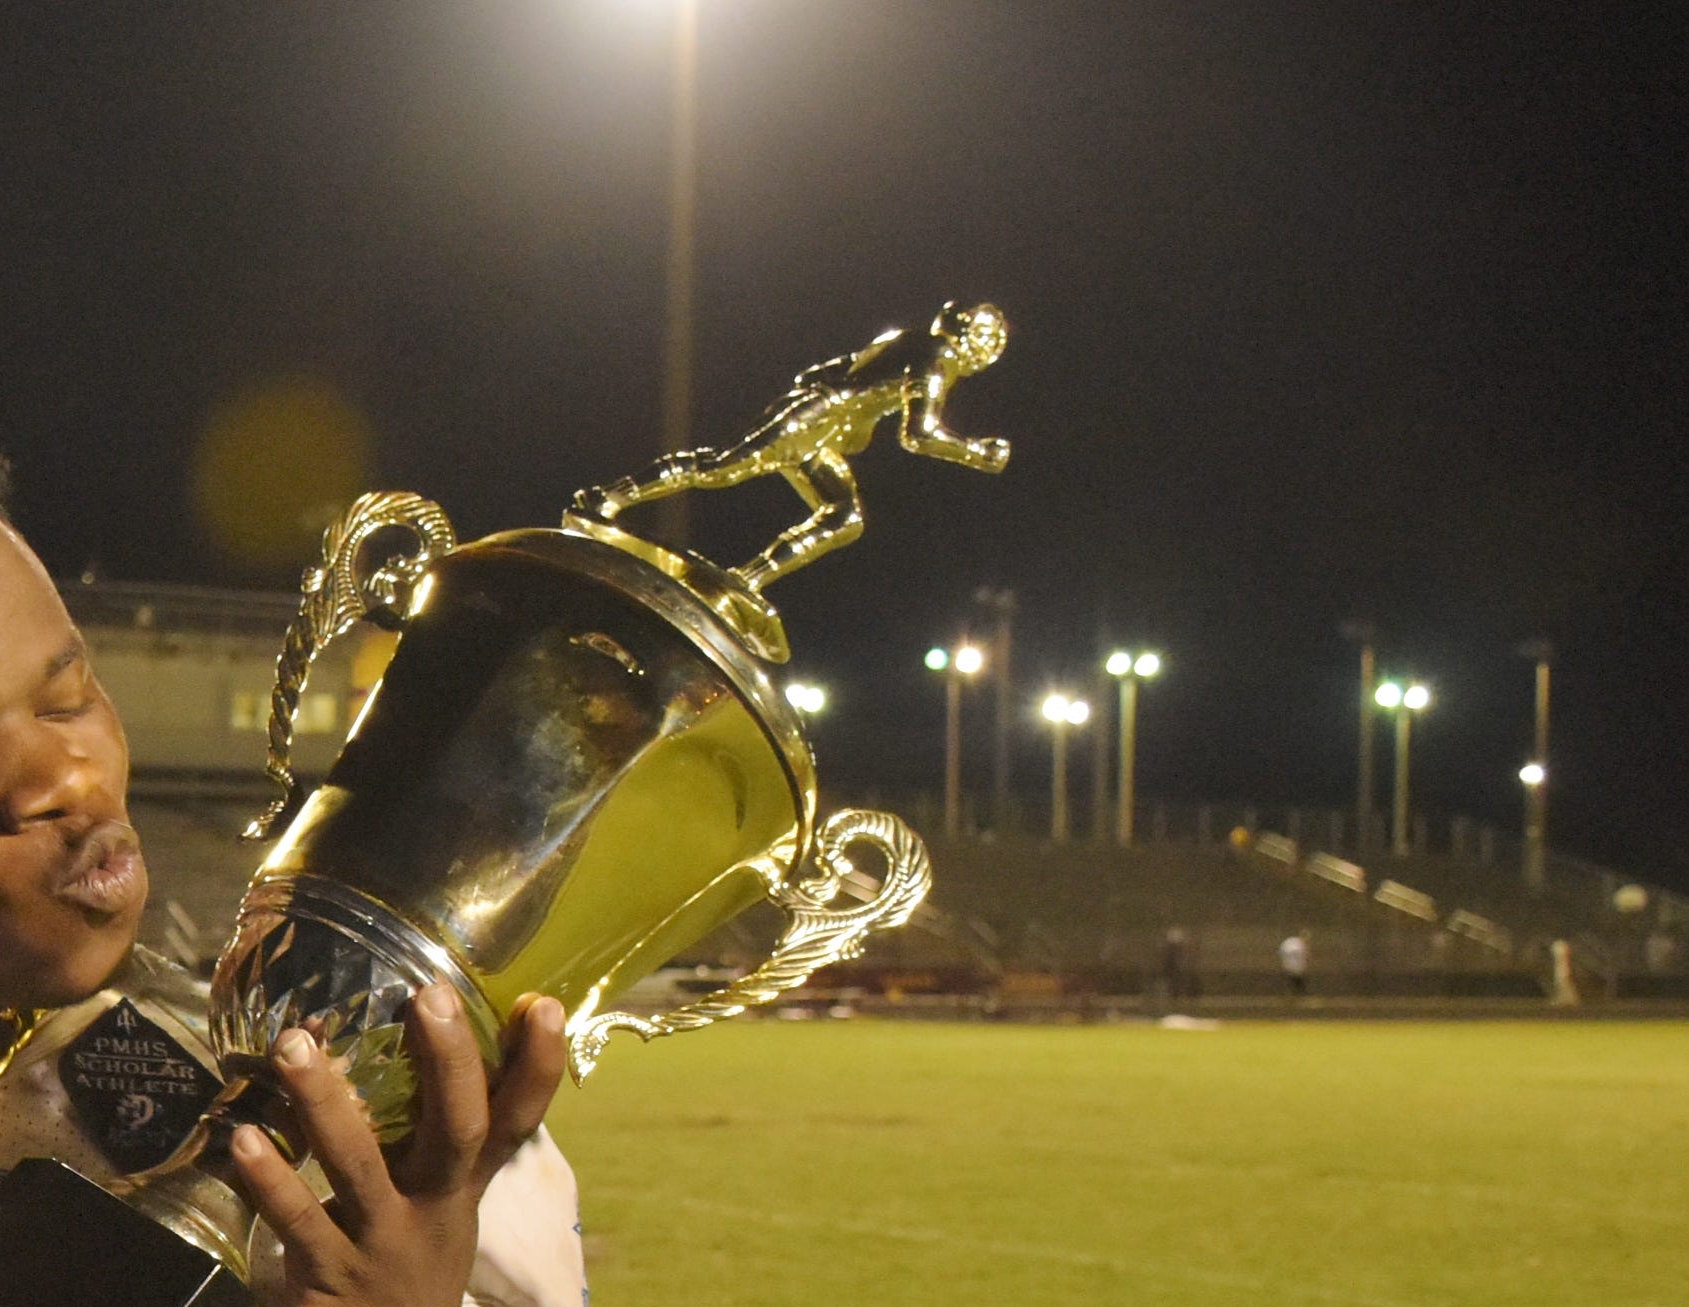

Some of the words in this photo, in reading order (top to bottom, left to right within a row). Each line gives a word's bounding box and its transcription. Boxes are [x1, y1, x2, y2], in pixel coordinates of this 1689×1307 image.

[95, 1037, 168, 1056] PMHS
[74, 1053, 196, 1080] SCHOLAR
[76, 1073, 198, 1096] ATHLETE
